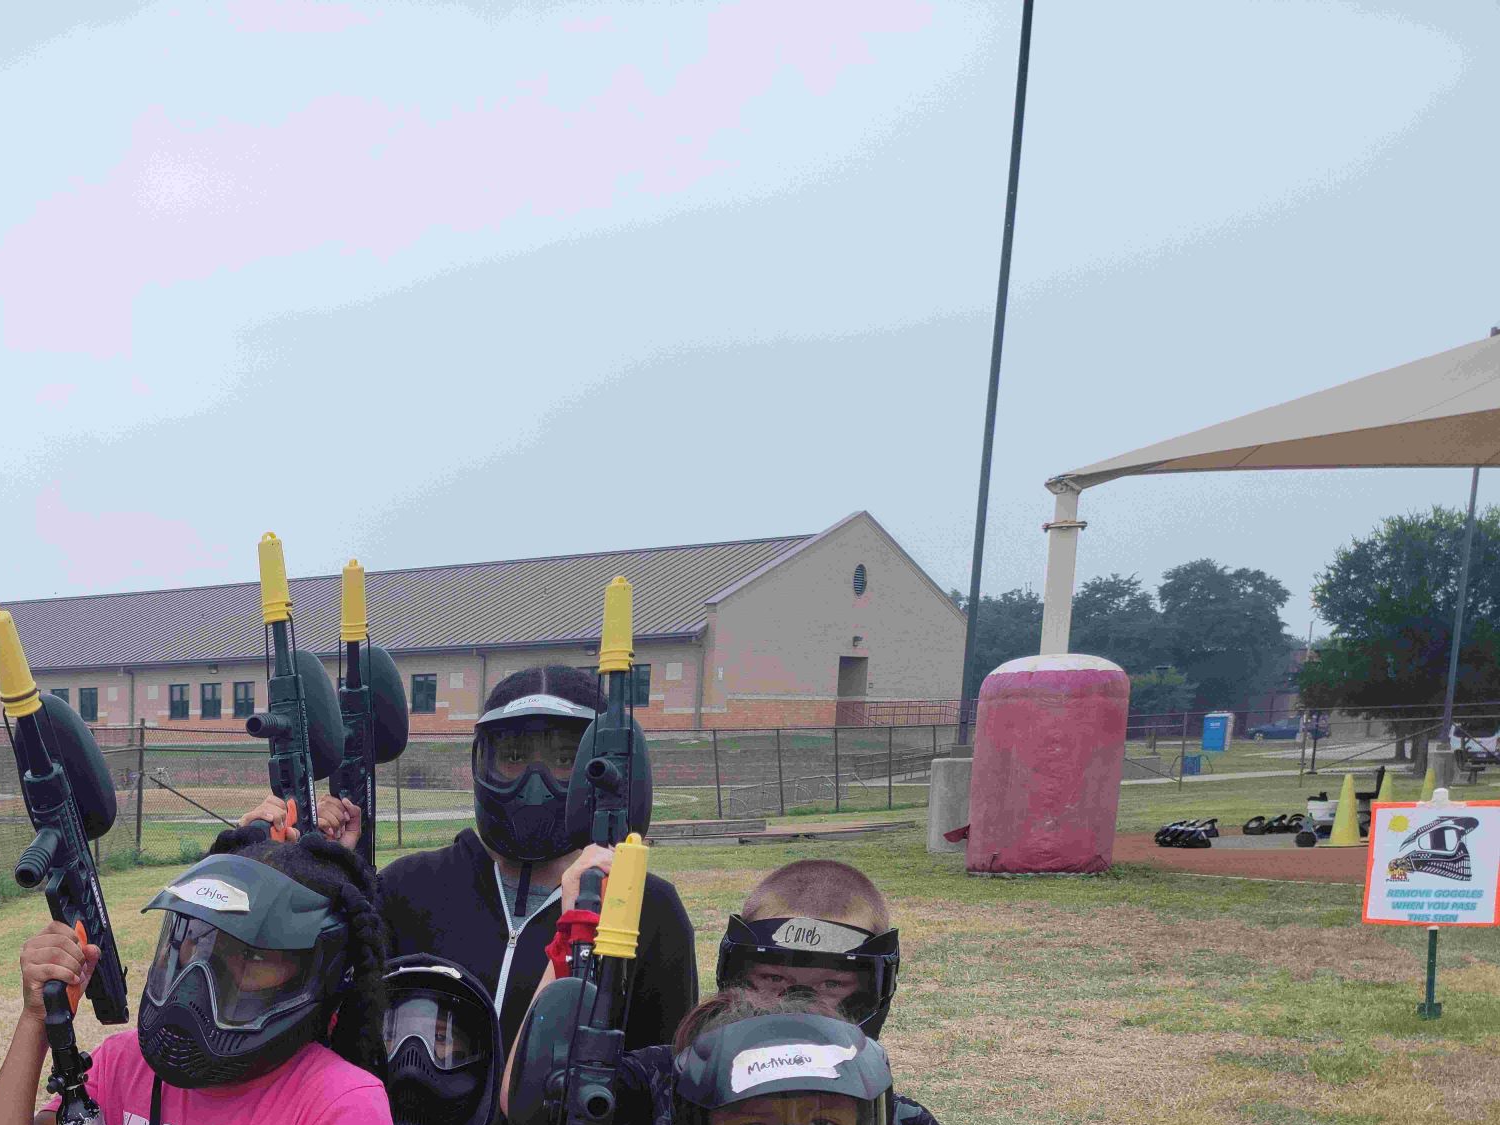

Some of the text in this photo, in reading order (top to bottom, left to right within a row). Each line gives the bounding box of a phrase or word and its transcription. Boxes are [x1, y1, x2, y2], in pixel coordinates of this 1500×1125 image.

[1387, 889, 1483, 898] REMOVE GOGGLES
[1392, 901, 1477, 910] WHEN YOU PASS
[1433, 914, 1458, 922] SIGN
